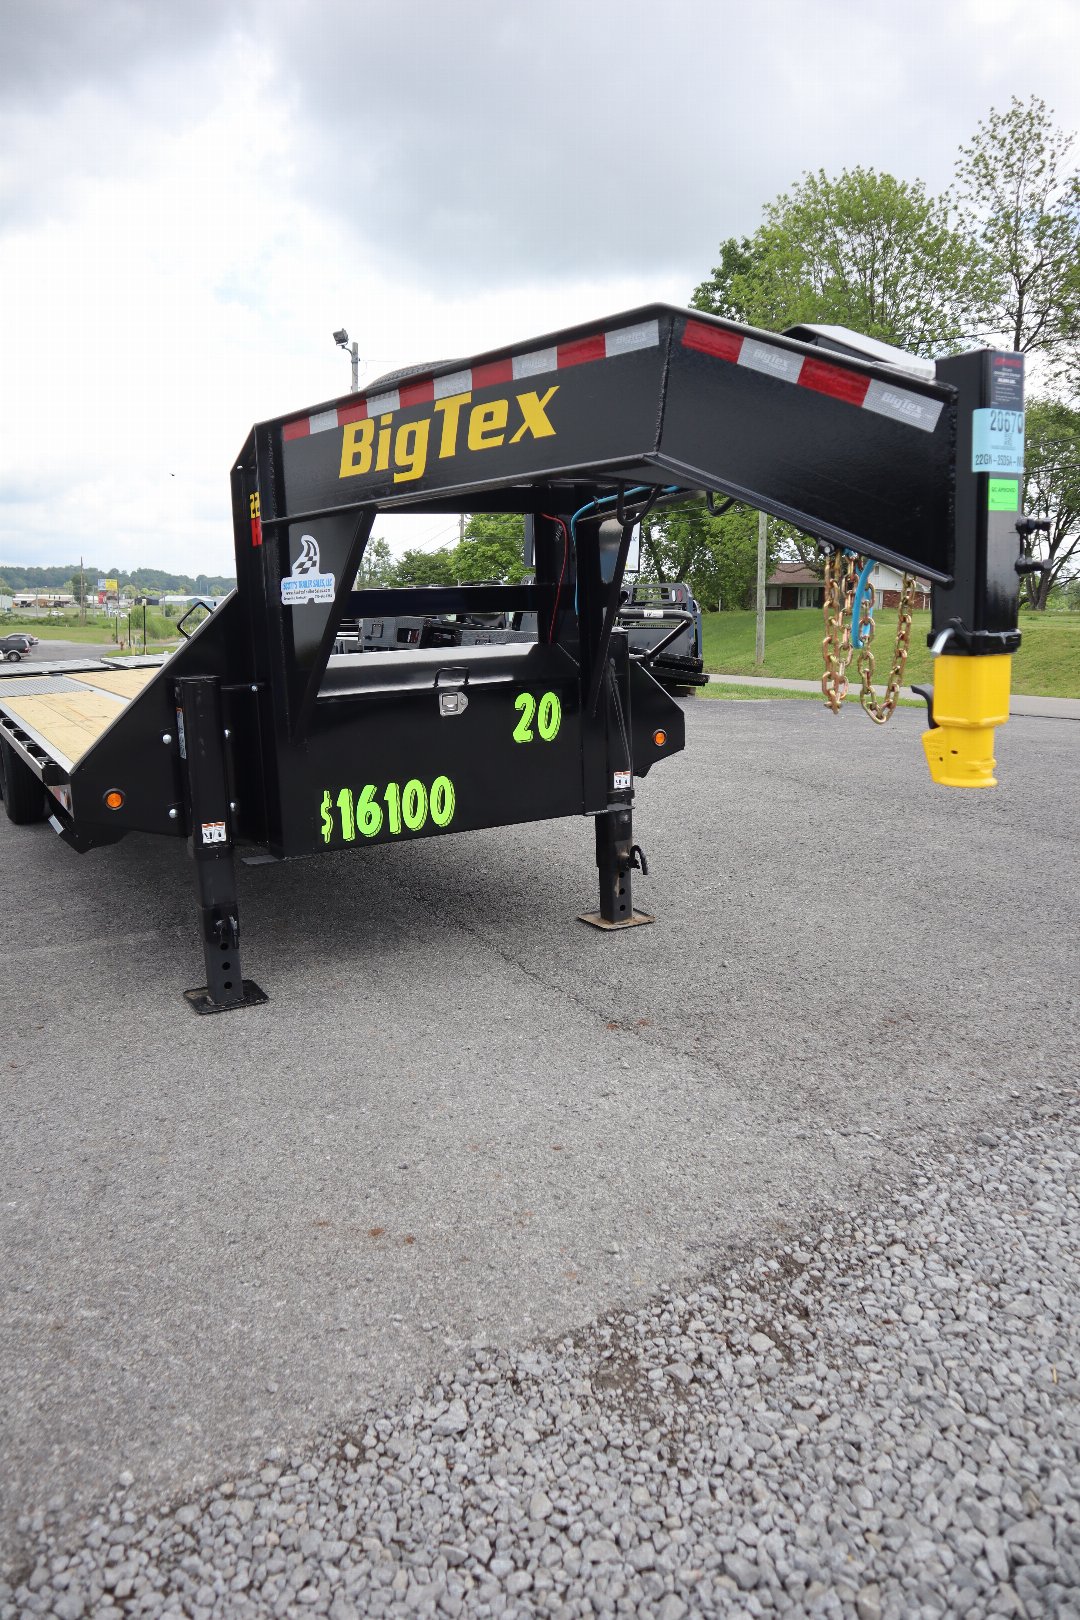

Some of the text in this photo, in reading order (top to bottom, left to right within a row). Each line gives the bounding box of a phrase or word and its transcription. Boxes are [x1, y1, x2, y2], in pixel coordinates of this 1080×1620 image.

[752, 349, 789, 368] BigTex
[881, 391, 923, 414] BigTex
[990, 409, 1024, 434] 20670
[339, 385, 560, 484] BigTex
[512, 691, 562, 743] 20
[320, 775, 456, 844] $16100
